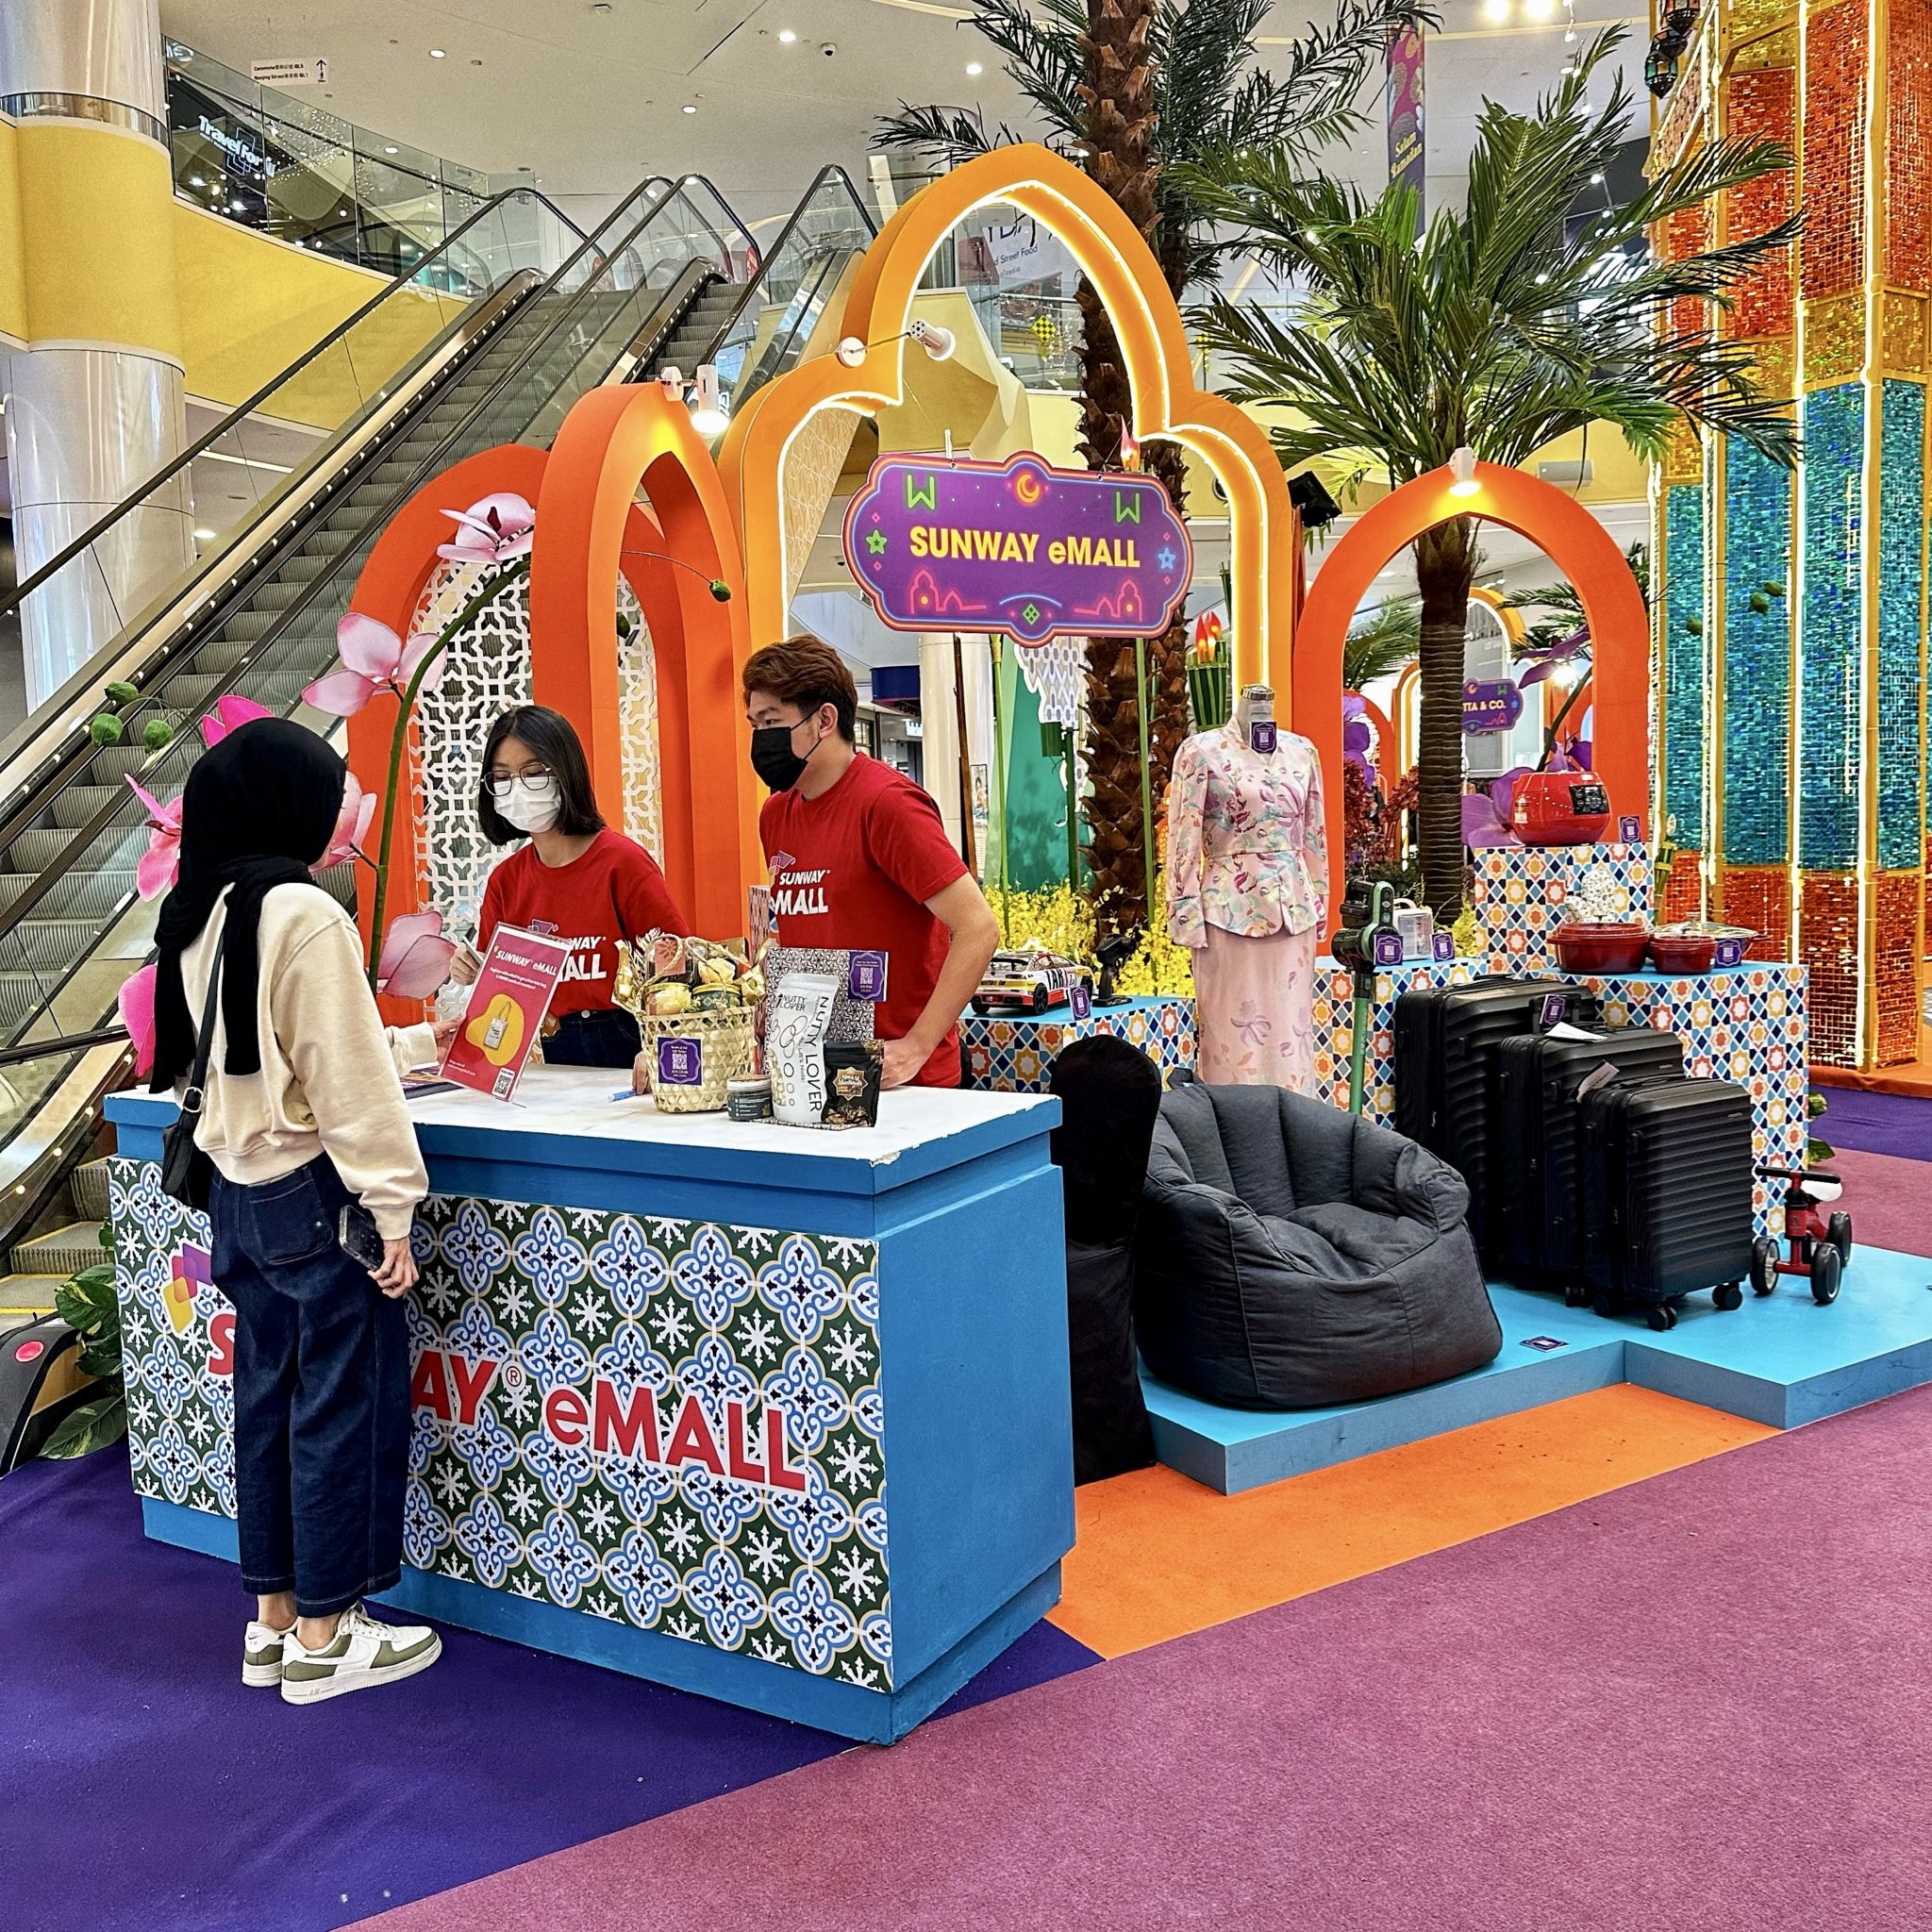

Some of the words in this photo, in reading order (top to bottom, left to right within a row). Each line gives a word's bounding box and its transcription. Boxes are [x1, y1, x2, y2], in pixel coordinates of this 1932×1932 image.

[1000, 251, 1020, 264] Street
[1021, 244, 1039, 257] Food
[909, 525, 1040, 563] SUNWAY
[1048, 536, 1141, 568] eMALL
[778, 869, 826, 886] SUNWAY
[770, 887, 829, 916] MALL
[569, 936, 602, 951] WAY
[495, 949, 531, 968] SUNWAY
[532, 962, 558, 976] eMALL
[780, 1001, 806, 1011] LOVER
[784, 994, 807, 1005] NUTTY
[804, 995, 830, 1047] NUTTY
[806, 1054, 823, 1112] LOVER
[545, 1379, 806, 1491] eMALL
